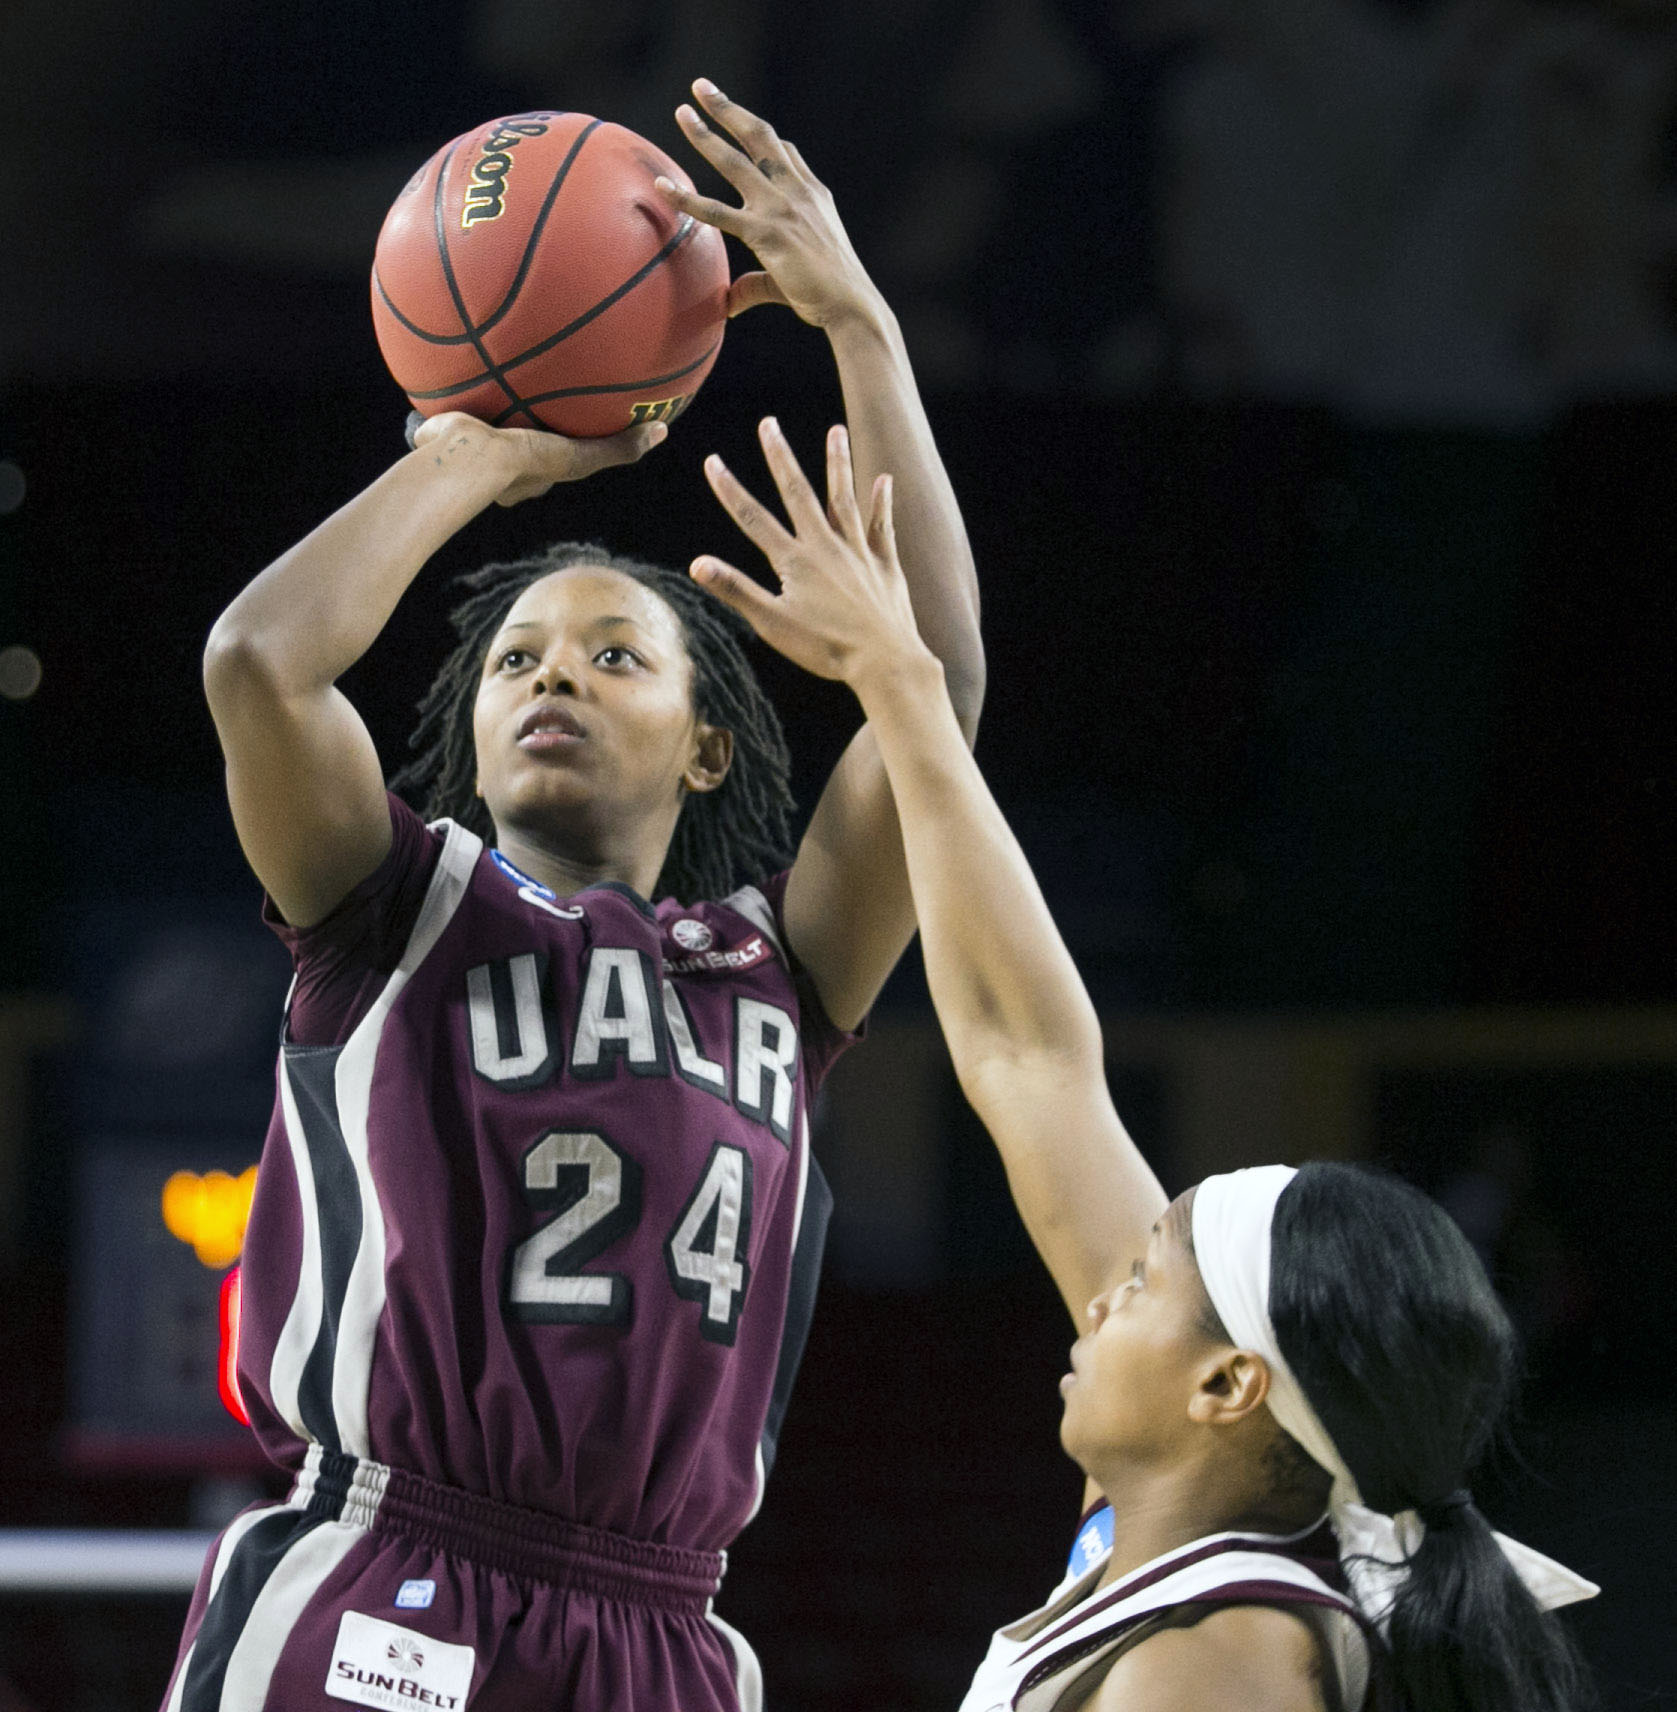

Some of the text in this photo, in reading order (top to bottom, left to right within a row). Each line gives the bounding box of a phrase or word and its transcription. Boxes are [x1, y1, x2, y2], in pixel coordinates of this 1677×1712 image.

[462, 111, 550, 228] ilson
[705, 938, 762, 969] BELT
[464, 946, 799, 1147] UALR
[502, 1129, 752, 1338] 24
[336, 1660, 459, 1710] SUN BELT
